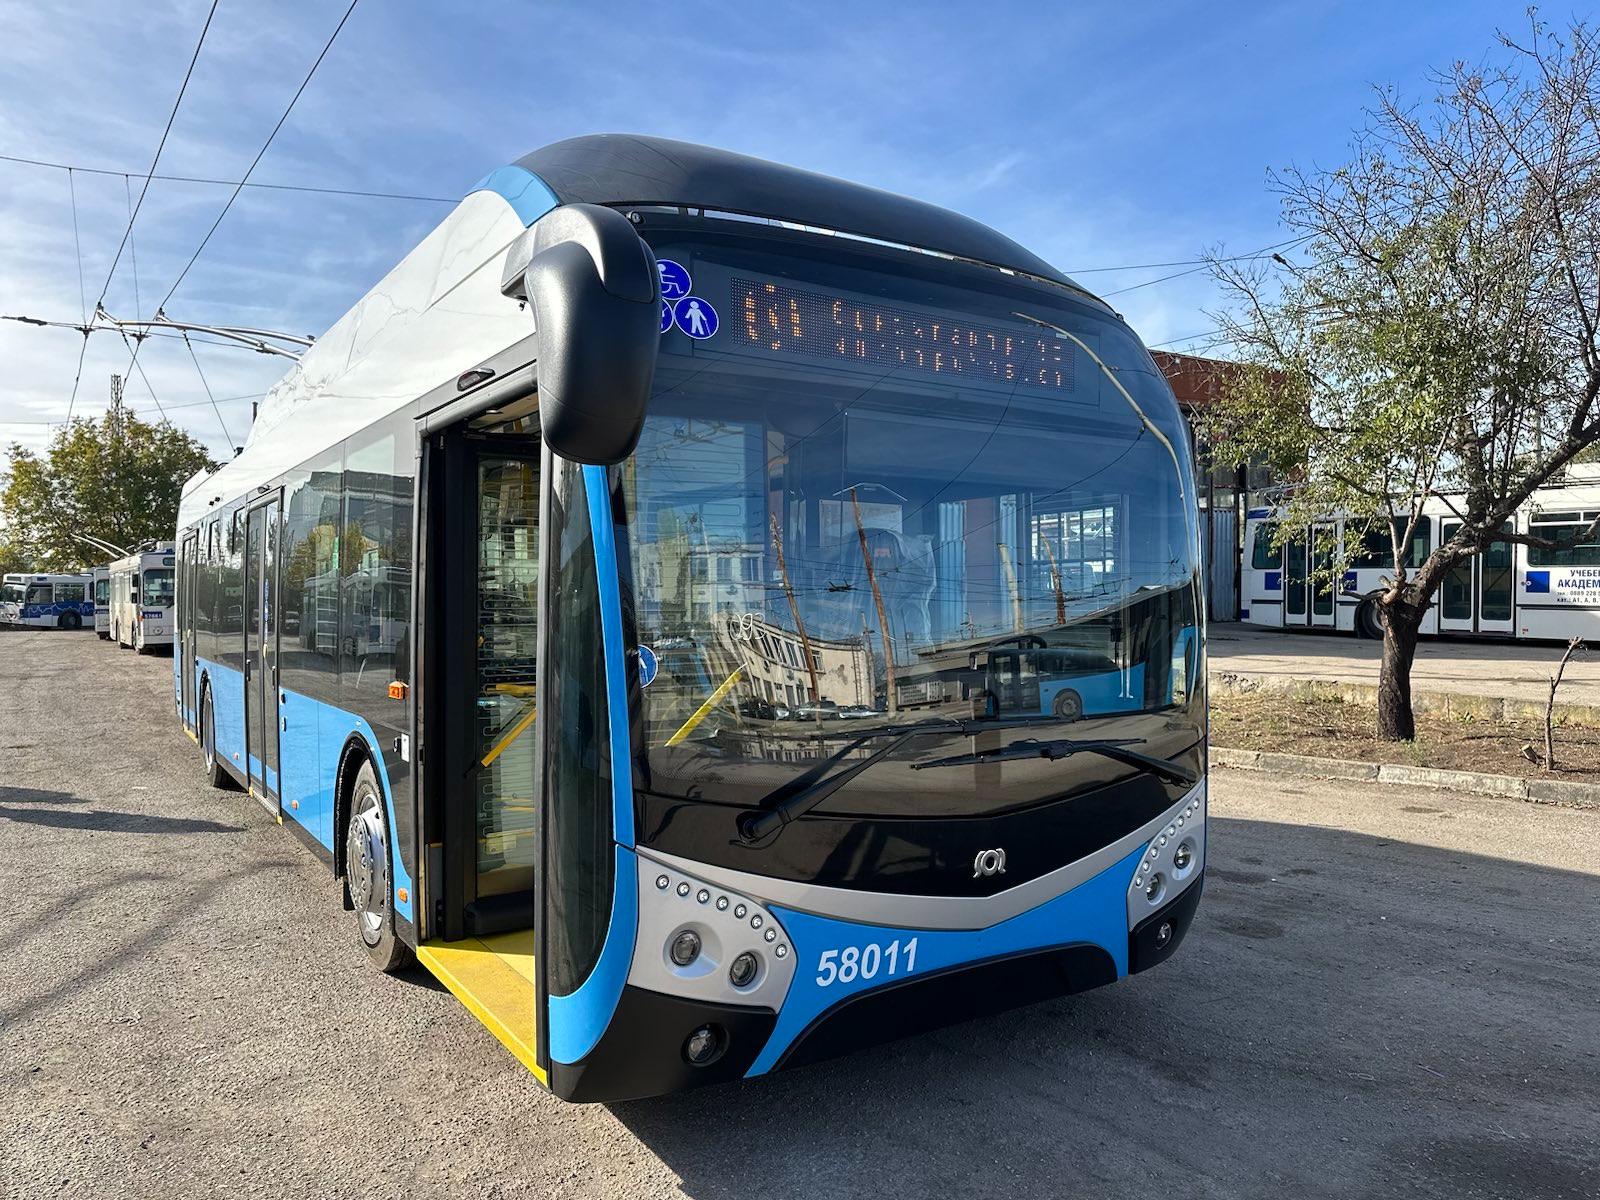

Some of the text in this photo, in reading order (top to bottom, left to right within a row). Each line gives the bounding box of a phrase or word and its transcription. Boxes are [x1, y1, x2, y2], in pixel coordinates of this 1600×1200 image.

[1570, 569, 1600, 577] УЧЕБЕ
[1558, 579, 1600, 589] АКАДЕМ
[815, 937, 918, 987] 58011
